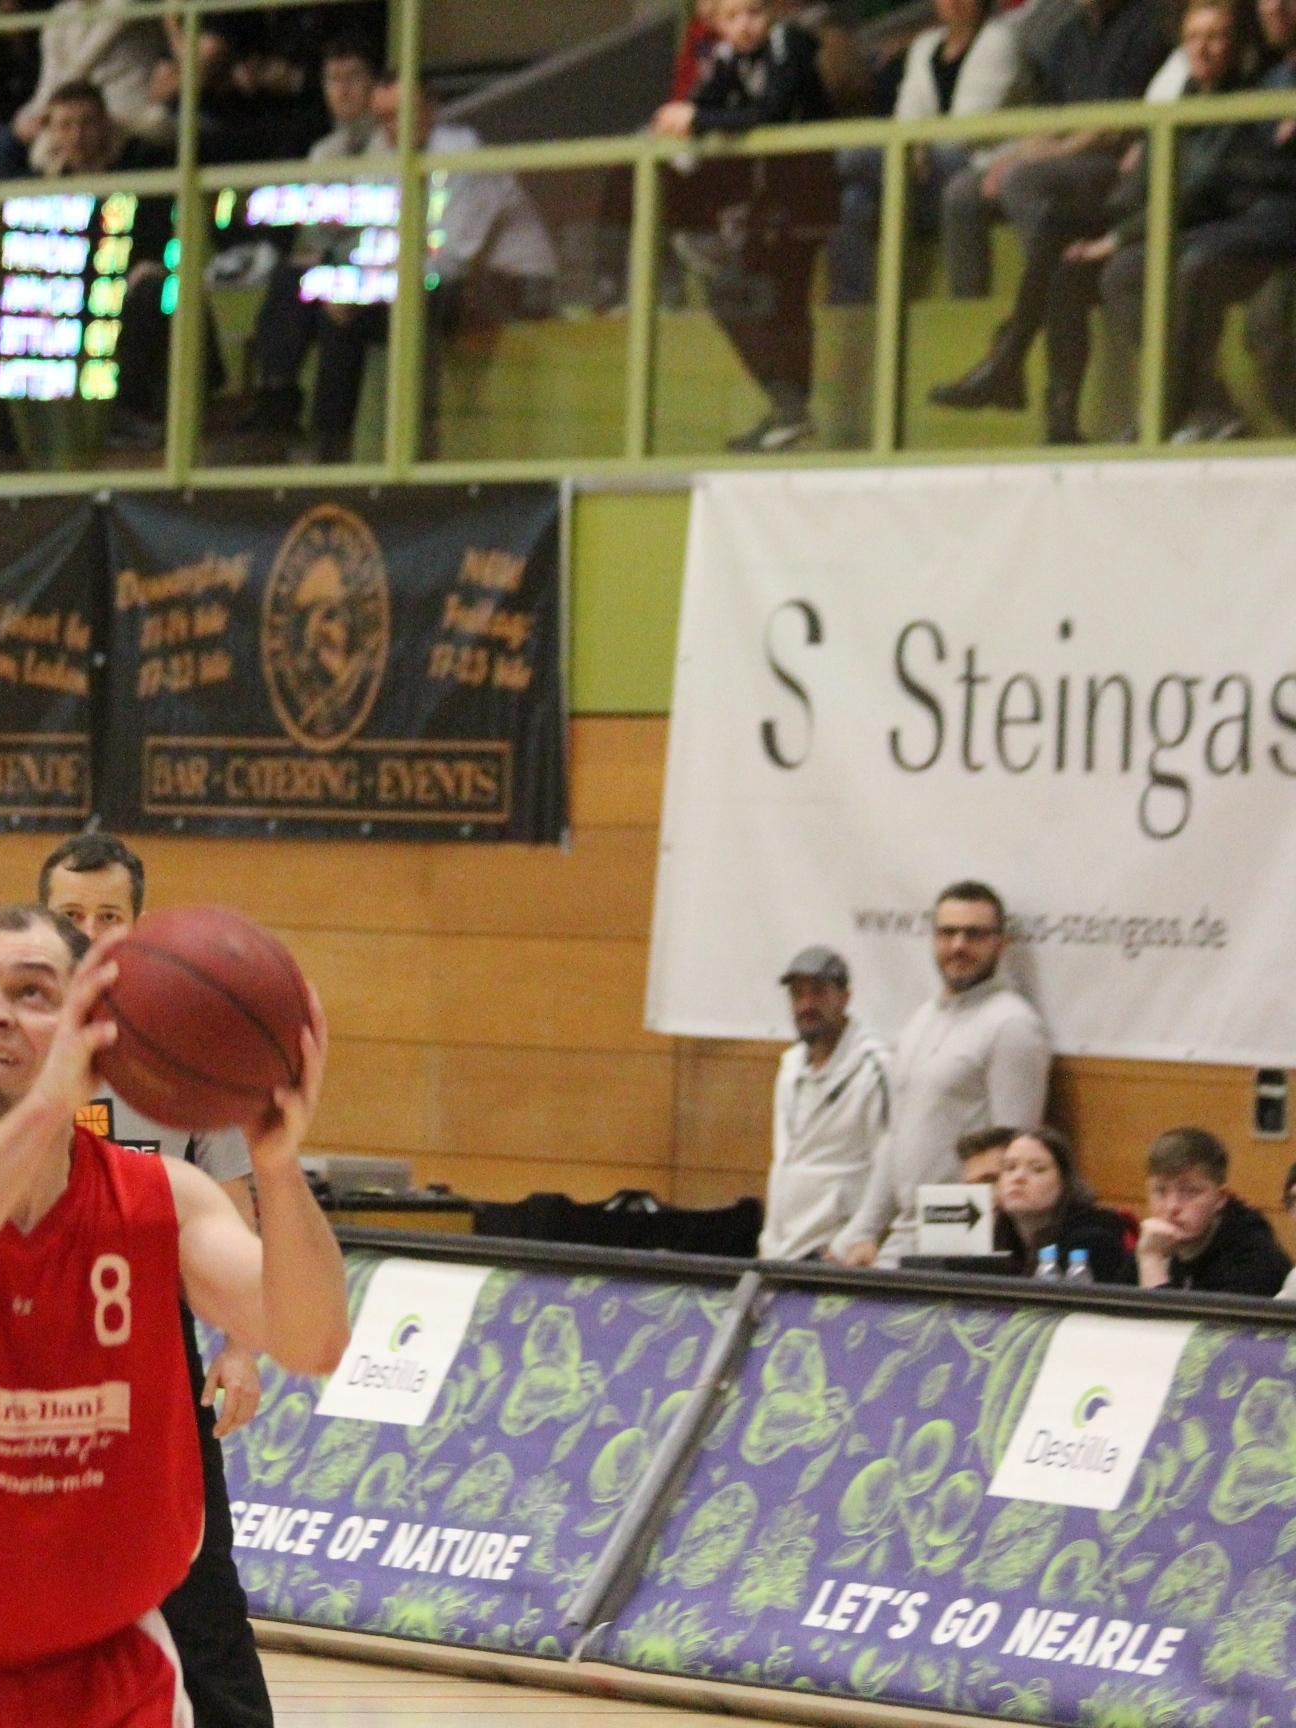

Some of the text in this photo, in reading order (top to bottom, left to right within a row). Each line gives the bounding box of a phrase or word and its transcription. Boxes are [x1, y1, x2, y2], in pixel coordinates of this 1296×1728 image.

[760, 598, 824, 770] S
[226, 757, 359, 799] CATERING
[379, 758, 497, 802] EVENTS
[90, 1253, 132, 1347] 8
[347, 1354, 427, 1393] Destilla
[1024, 1429, 1120, 1474] Destilla
[325, 1515, 390, 1562] OF
[378, 1521, 532, 1581] NATURE
[800, 1579, 1187, 1677] LET'S GO NEARLE
